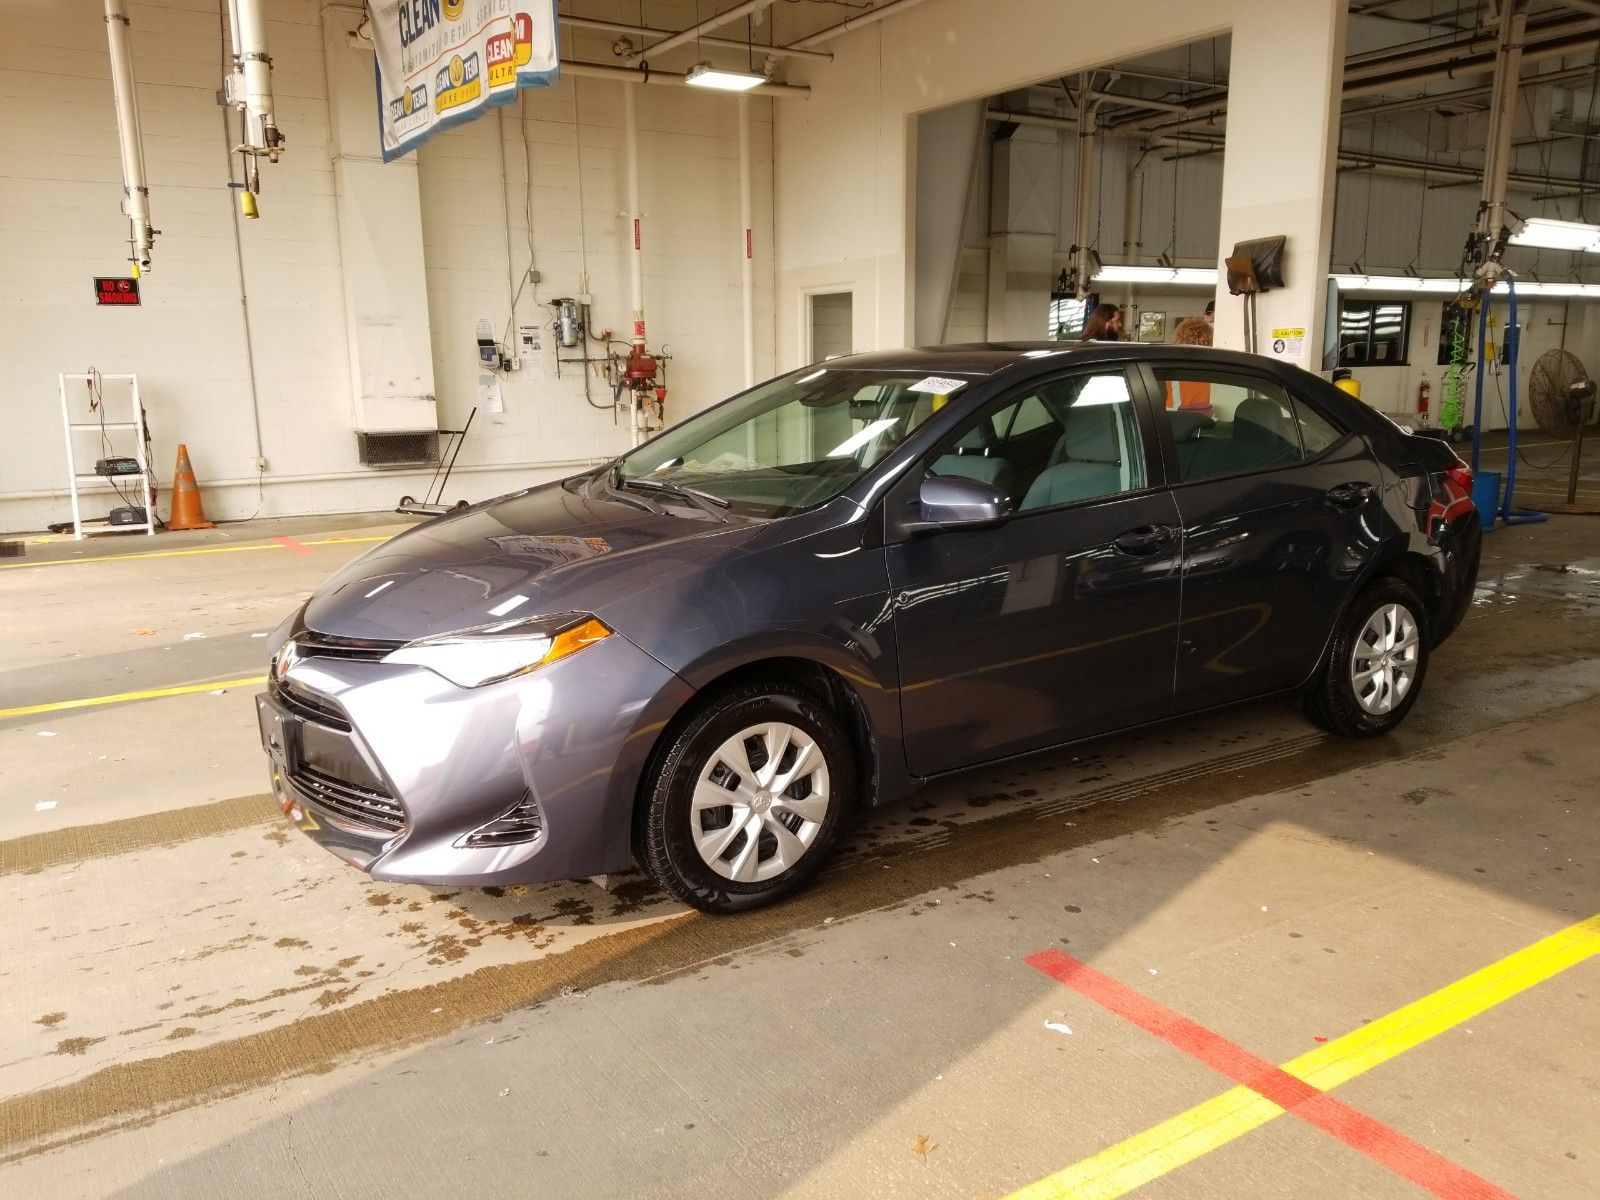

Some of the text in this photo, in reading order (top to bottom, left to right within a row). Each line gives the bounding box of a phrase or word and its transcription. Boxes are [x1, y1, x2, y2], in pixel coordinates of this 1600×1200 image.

[399, 0, 440, 48] CLEAN
[102, 280, 115, 291] NO
[99, 292, 137, 303] SMOKING
